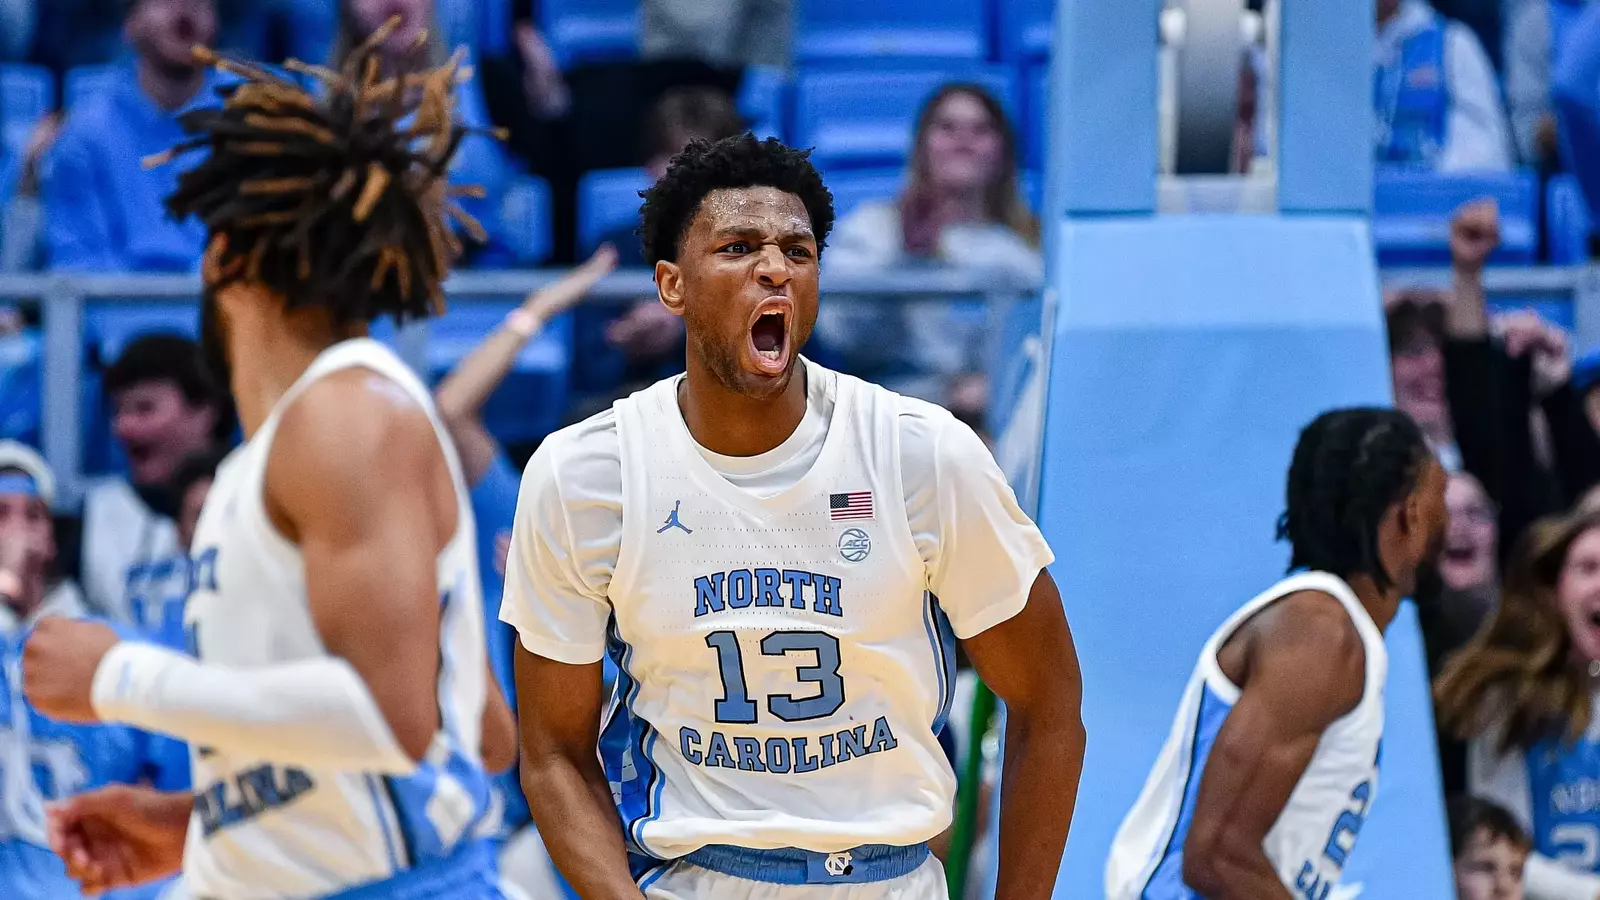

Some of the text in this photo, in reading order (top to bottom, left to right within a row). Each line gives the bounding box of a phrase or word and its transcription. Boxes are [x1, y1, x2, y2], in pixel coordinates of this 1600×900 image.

[841, 538, 869, 549] ACC
[694, 568, 843, 618] NORTH
[704, 630, 846, 725] 13
[679, 716, 898, 774] CAROLINA
